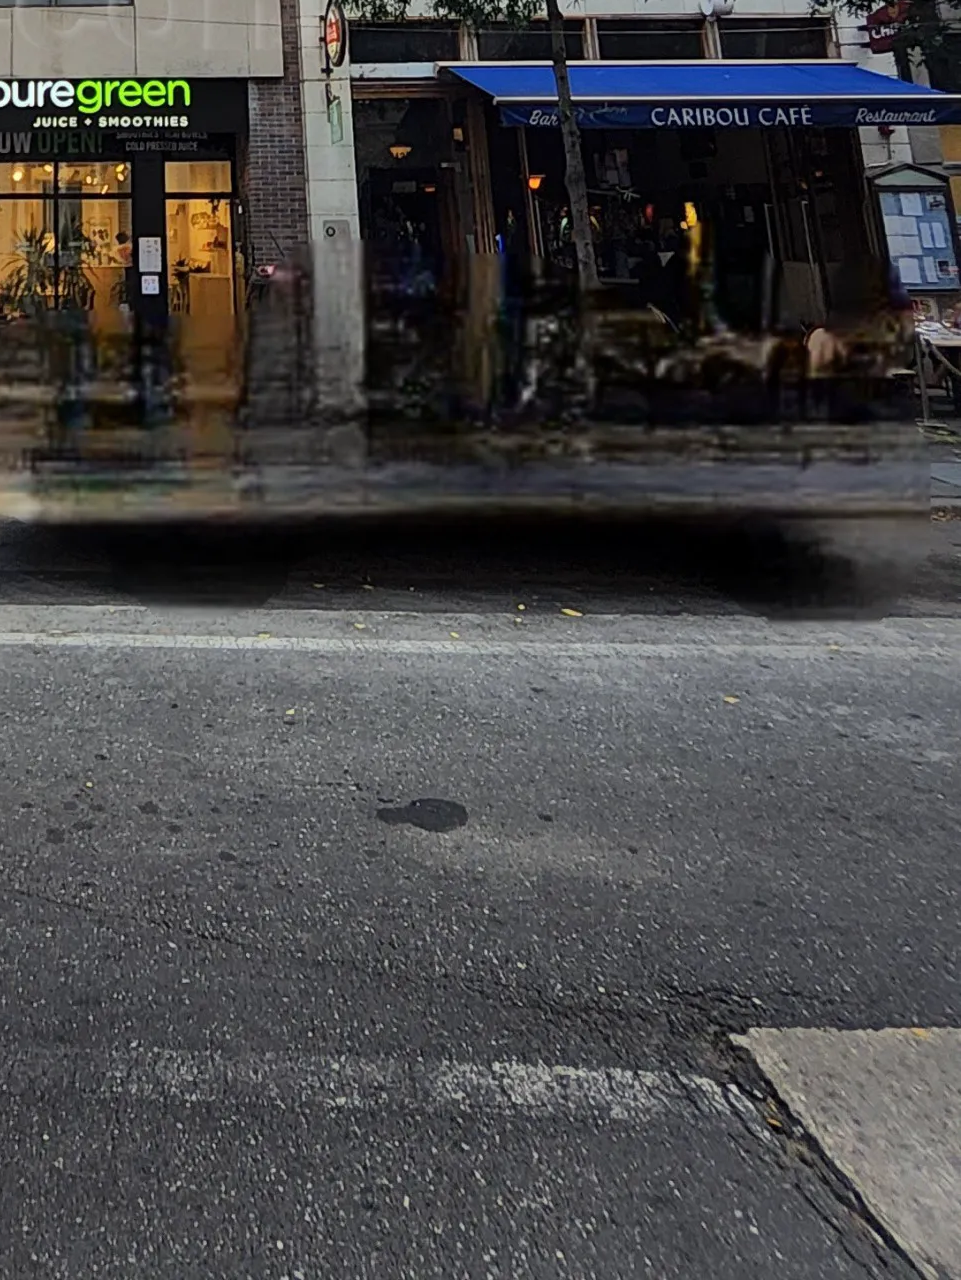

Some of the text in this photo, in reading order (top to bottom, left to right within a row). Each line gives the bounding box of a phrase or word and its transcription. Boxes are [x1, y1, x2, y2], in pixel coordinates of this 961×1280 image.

[33, 116, 78, 128] JUICE
[98, 116, 189, 128] SMOOTHIES
[529, 109, 559, 126] Bar
[651, 107, 749, 126] CARIBOU
[758, 104, 814, 126] CAFÉ
[855, 107, 937, 124] Restaurant
